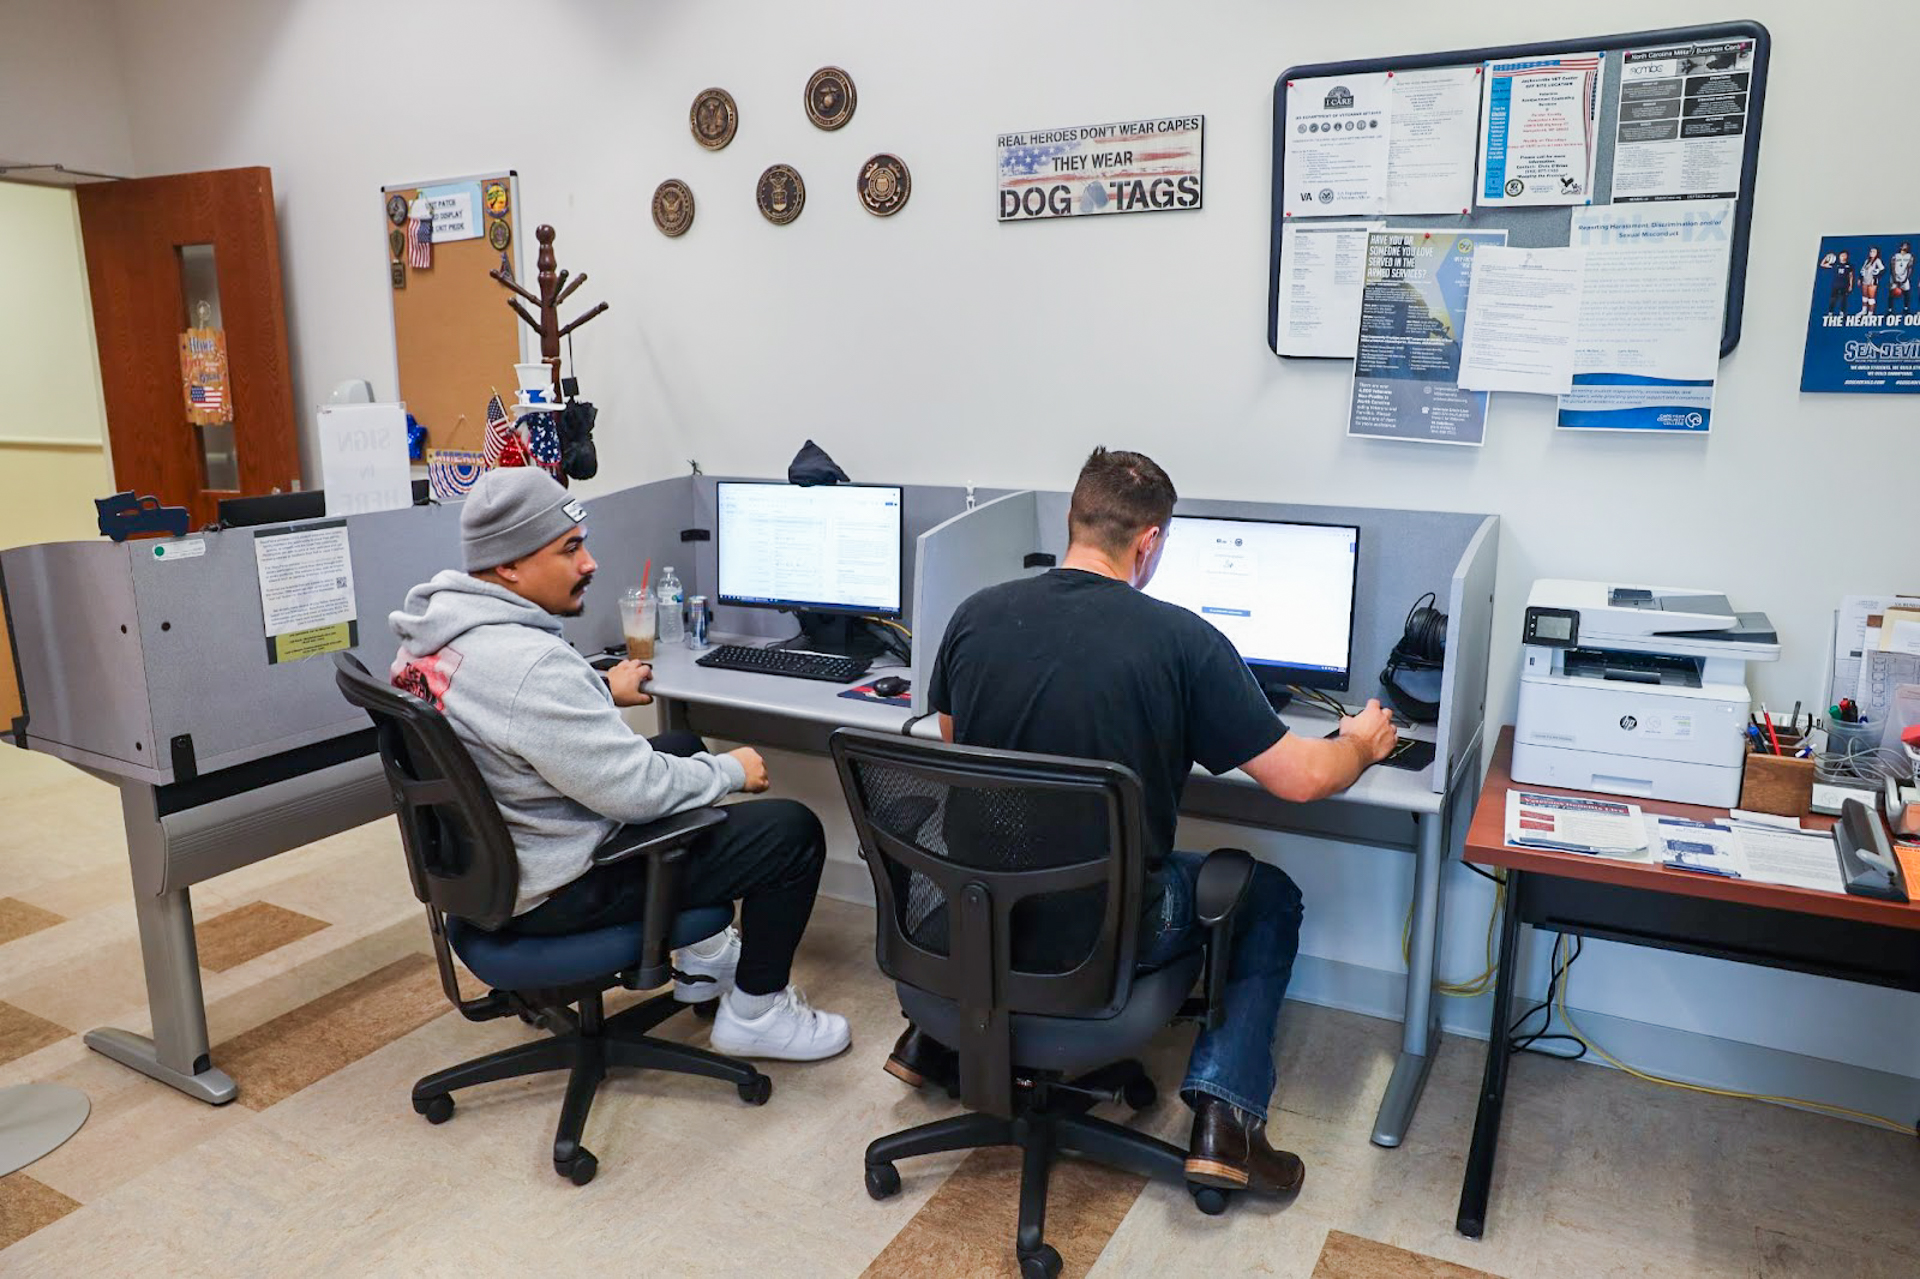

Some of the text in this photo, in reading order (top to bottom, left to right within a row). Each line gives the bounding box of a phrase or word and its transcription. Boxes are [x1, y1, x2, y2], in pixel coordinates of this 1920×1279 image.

[998, 118, 1199, 148] REAL HEROES DON'T WEAR CAPES
[1052, 151, 1133, 172] THEY WEAR
[1000, 175, 1200, 218] DOG TAGS
[1300, 192, 1312, 202] VA
[1370, 234, 1414, 245] HAVE YOU OR
[1369, 246, 1433, 257] SOMEONE YOU LOVE
[1369, 257, 1416, 268] SERVED IN THE
[1367, 268, 1426, 278] ARMED SERVICES?
[1823, 315, 1843, 327] THE
[1846, 315, 1884, 327] HEART
[1886, 315, 1902, 326] OF
[435, 450, 484, 463] AMERIC
[1622, 714, 1636, 732] hp
